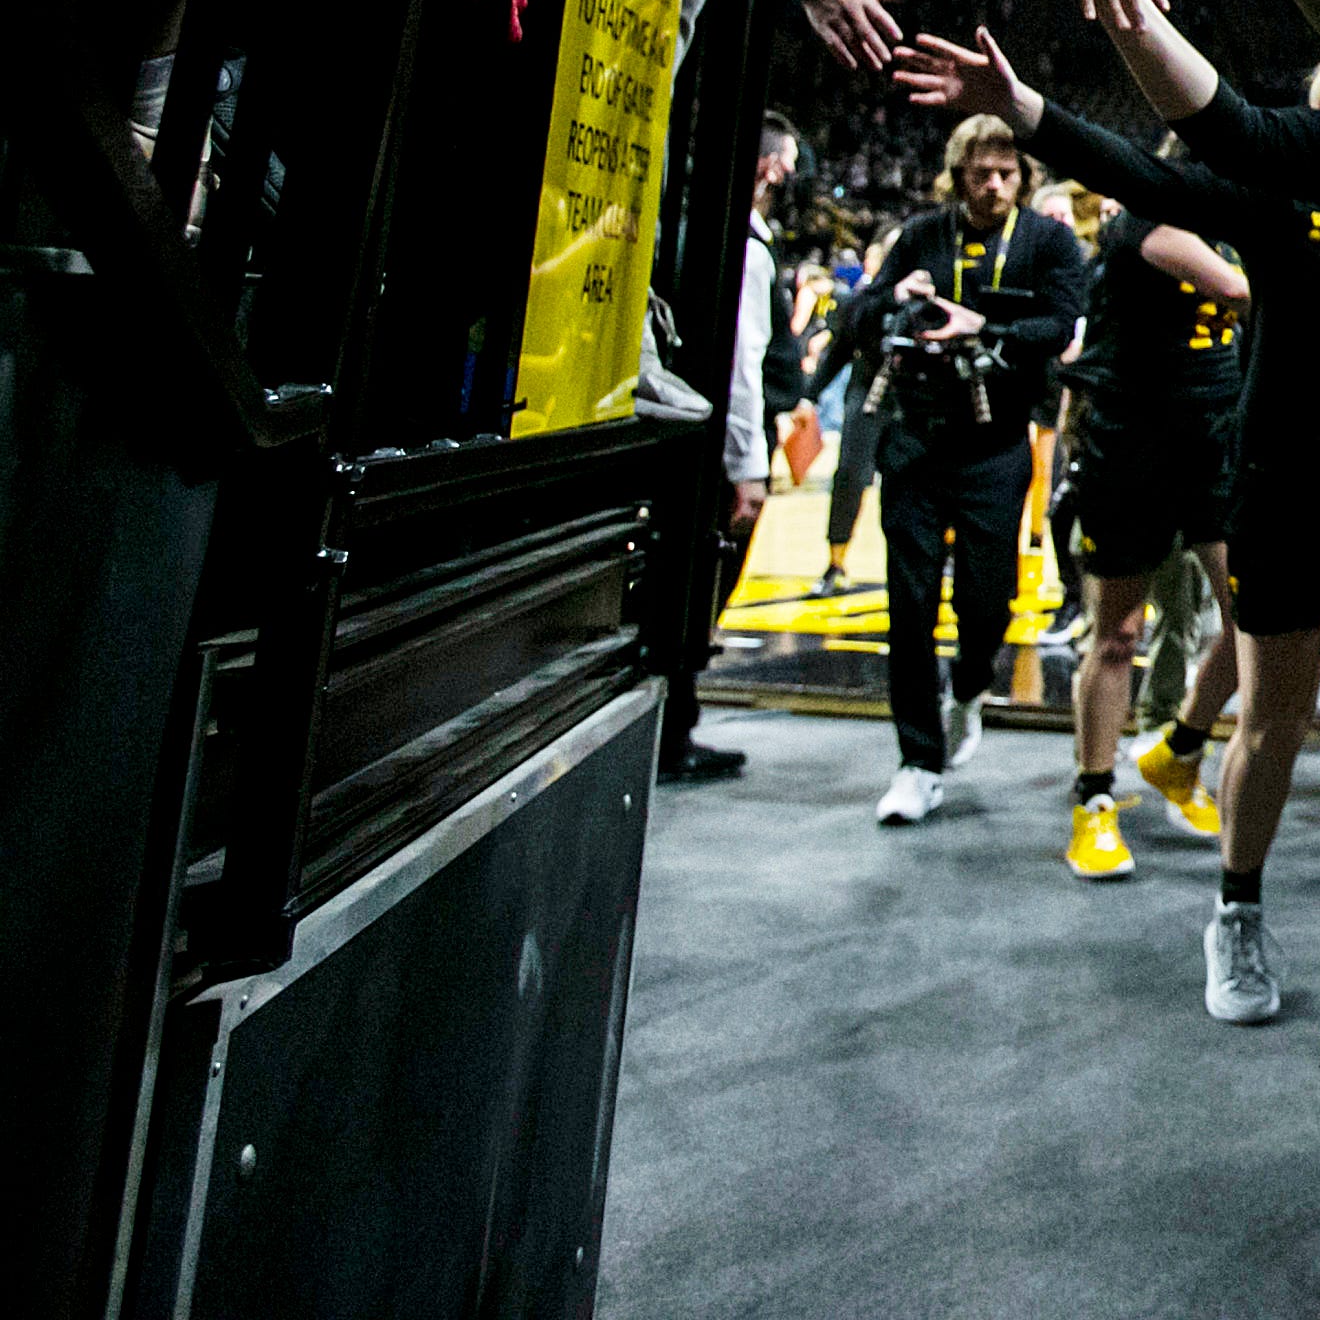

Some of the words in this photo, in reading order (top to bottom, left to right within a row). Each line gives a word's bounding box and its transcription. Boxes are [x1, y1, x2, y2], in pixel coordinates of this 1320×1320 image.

[580, 52, 605, 100] END
[567, 120, 620, 174] REOPENS
[567, 190, 603, 233] TEAM
[582, 264, 613, 303] AREA
